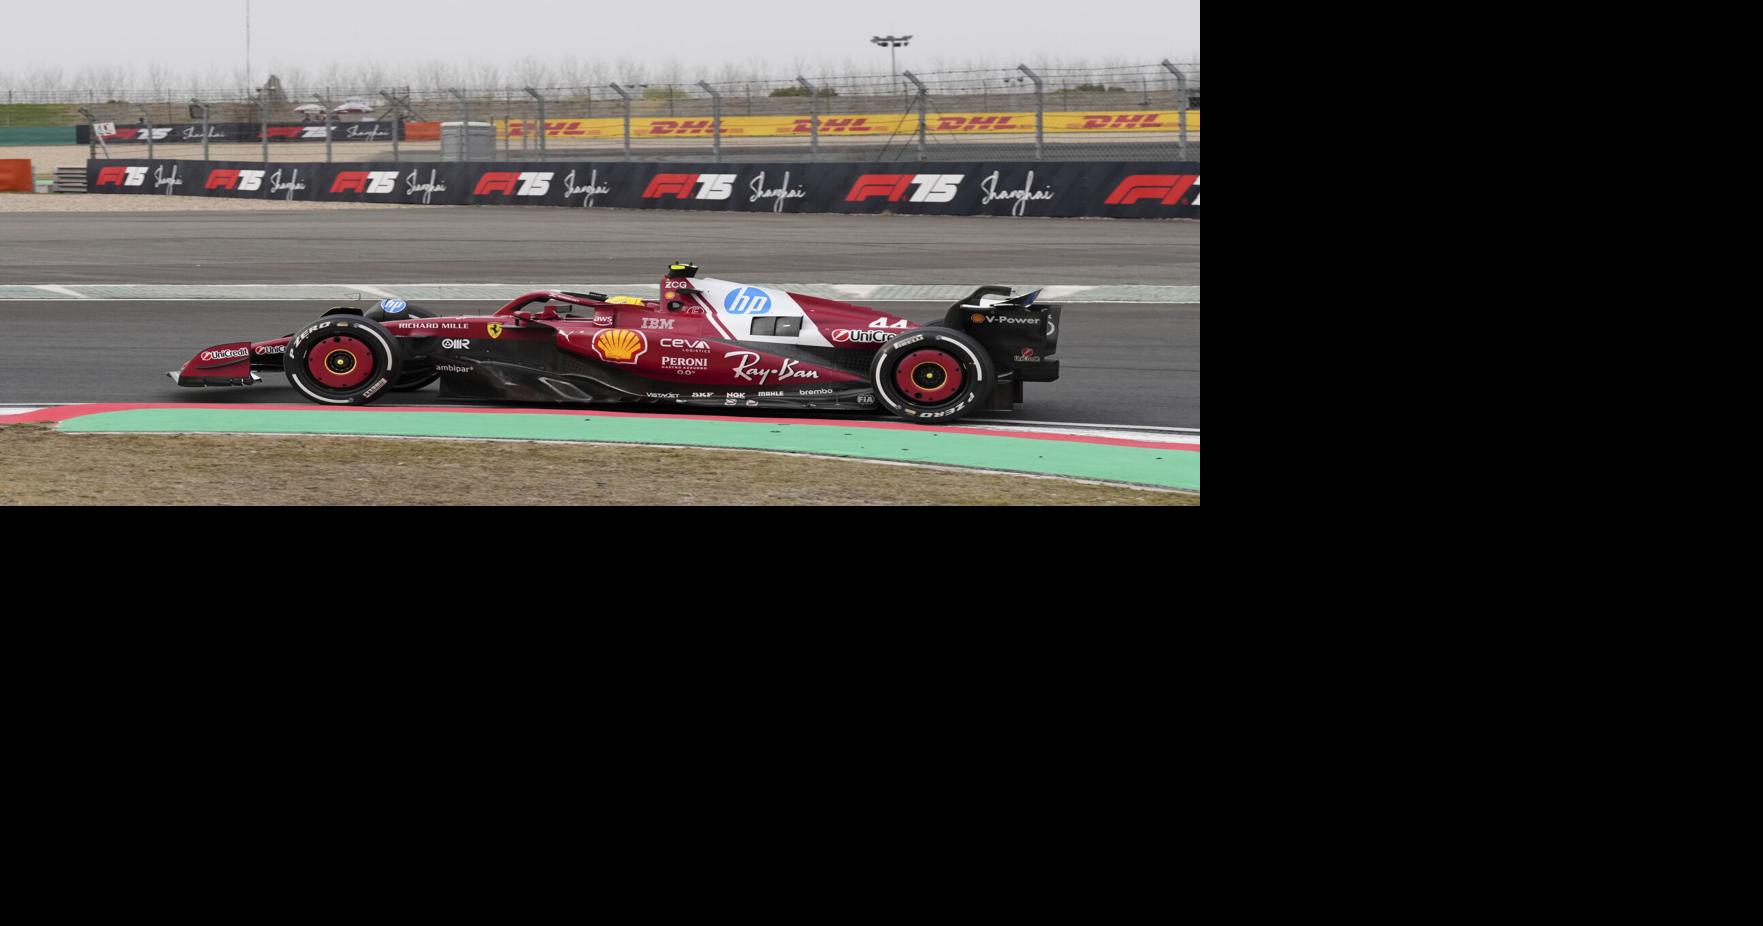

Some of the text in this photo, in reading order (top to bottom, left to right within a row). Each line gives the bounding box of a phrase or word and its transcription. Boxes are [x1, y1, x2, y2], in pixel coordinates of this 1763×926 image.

[649, 120, 727, 134] DHL
[792, 118, 871, 132] DHL
[937, 116, 1018, 130] DHL
[1082, 114, 1163, 128] DHL
[509, 122, 586, 136] DHL
[270, 168, 305, 200] Shanghai
[406, 169, 446, 204] Shanghai
[564, 169, 609, 207] Shanghai
[749, 171, 806, 213] Shanghai
[981, 171, 1054, 216] Shanghai
[382, 299, 404, 314] hp
[729, 287, 768, 314] hp
[641, 317, 675, 330] IBM
[869, 316, 908, 329] 44
[985, 316, 1041, 324] V-Power
[211, 347, 249, 360] UniCredit
[661, 356, 708, 368] PERONI
[724, 351, 820, 385] Ray-Ban
